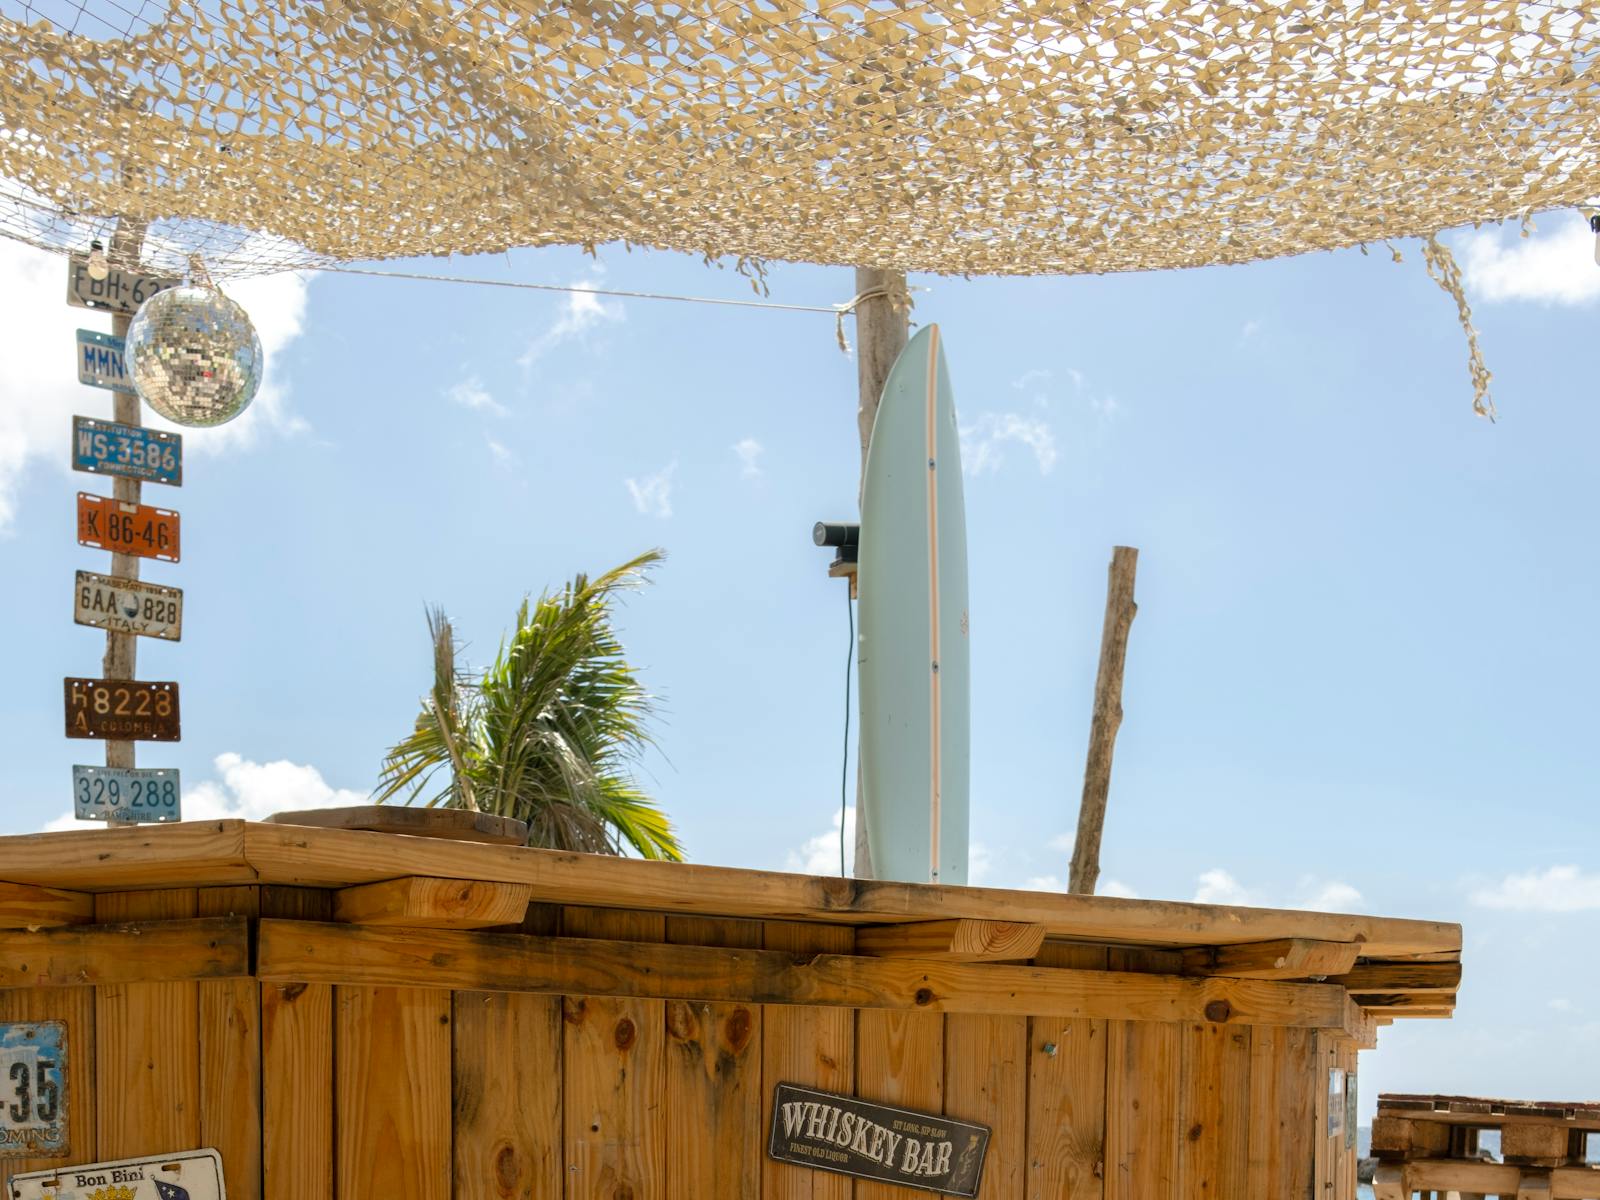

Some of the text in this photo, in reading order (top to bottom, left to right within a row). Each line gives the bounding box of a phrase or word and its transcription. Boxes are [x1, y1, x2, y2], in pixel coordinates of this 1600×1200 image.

[84, 345, 128, 379] MMN
[109, 513, 169, 549] 86-46
[81, 587, 176, 624] 6AA 828
[108, 617, 149, 631] ITALY
[94, 687, 171, 716] 8228
[79, 777, 175, 807] 329 288
[781, 1101, 953, 1177] WHISKEY BAR
[790, 1142, 849, 1163] FINEST OLD LIQUOR
[75, 1166, 144, 1188] Bon Bini
